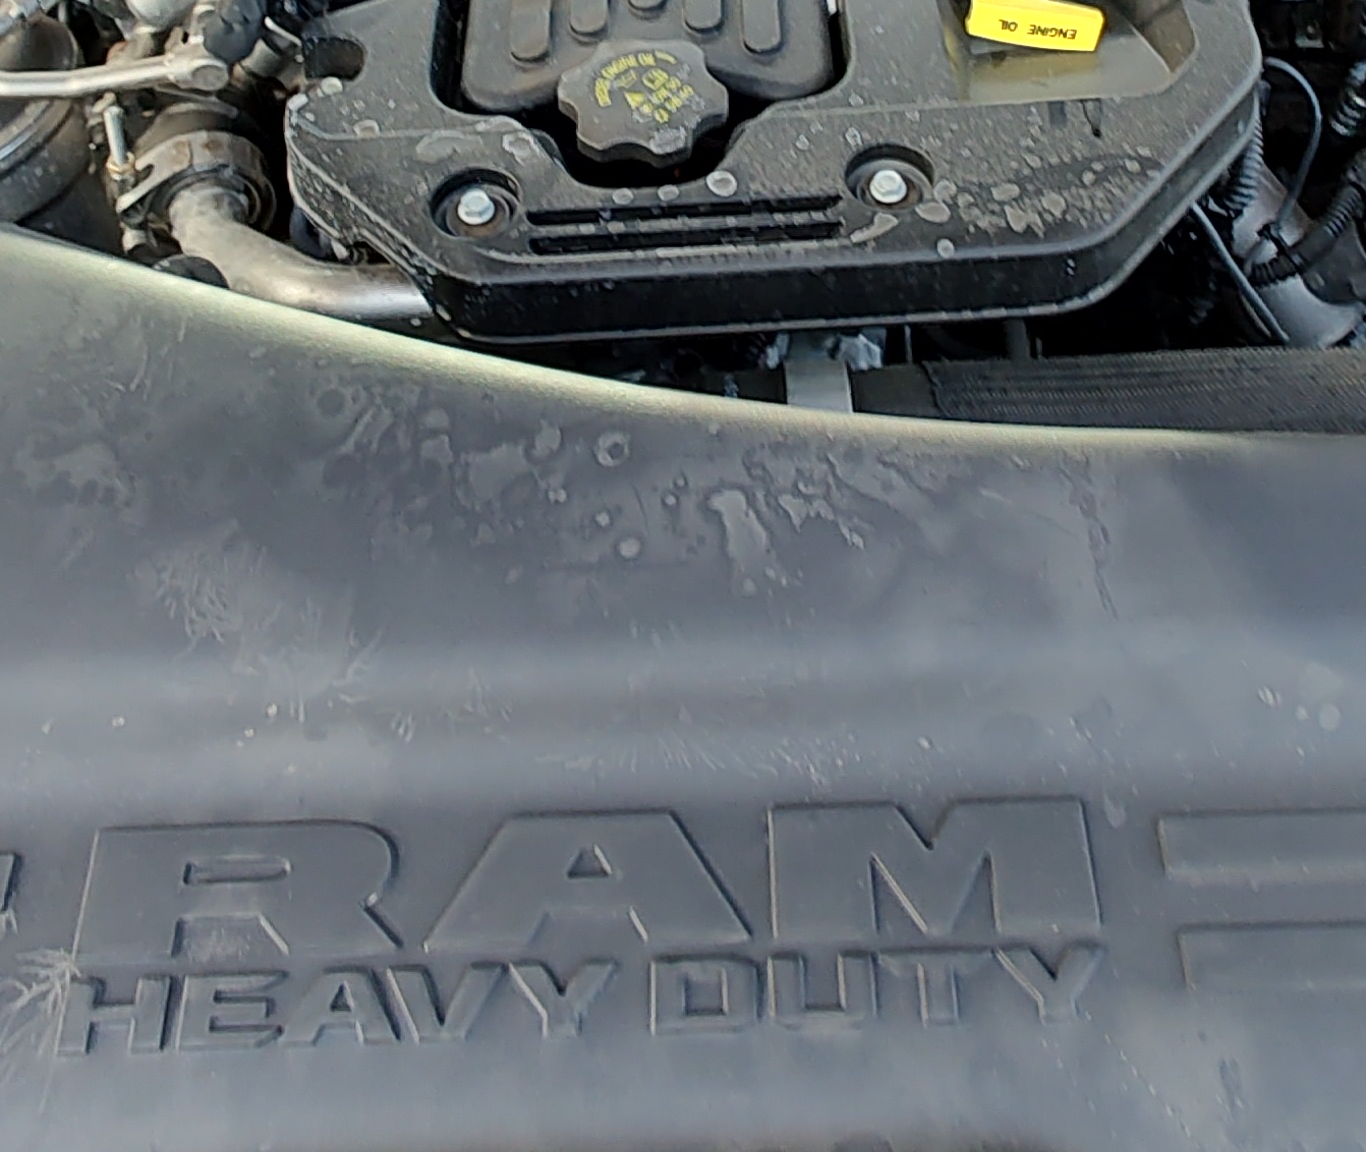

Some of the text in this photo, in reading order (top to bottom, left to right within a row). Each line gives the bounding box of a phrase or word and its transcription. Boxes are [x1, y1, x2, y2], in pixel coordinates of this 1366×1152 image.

[999, 20, 1077, 40] ENGINE OIL
[71, 794, 1105, 958] RAM
[55, 942, 1109, 1055] HEAVY DUTY
